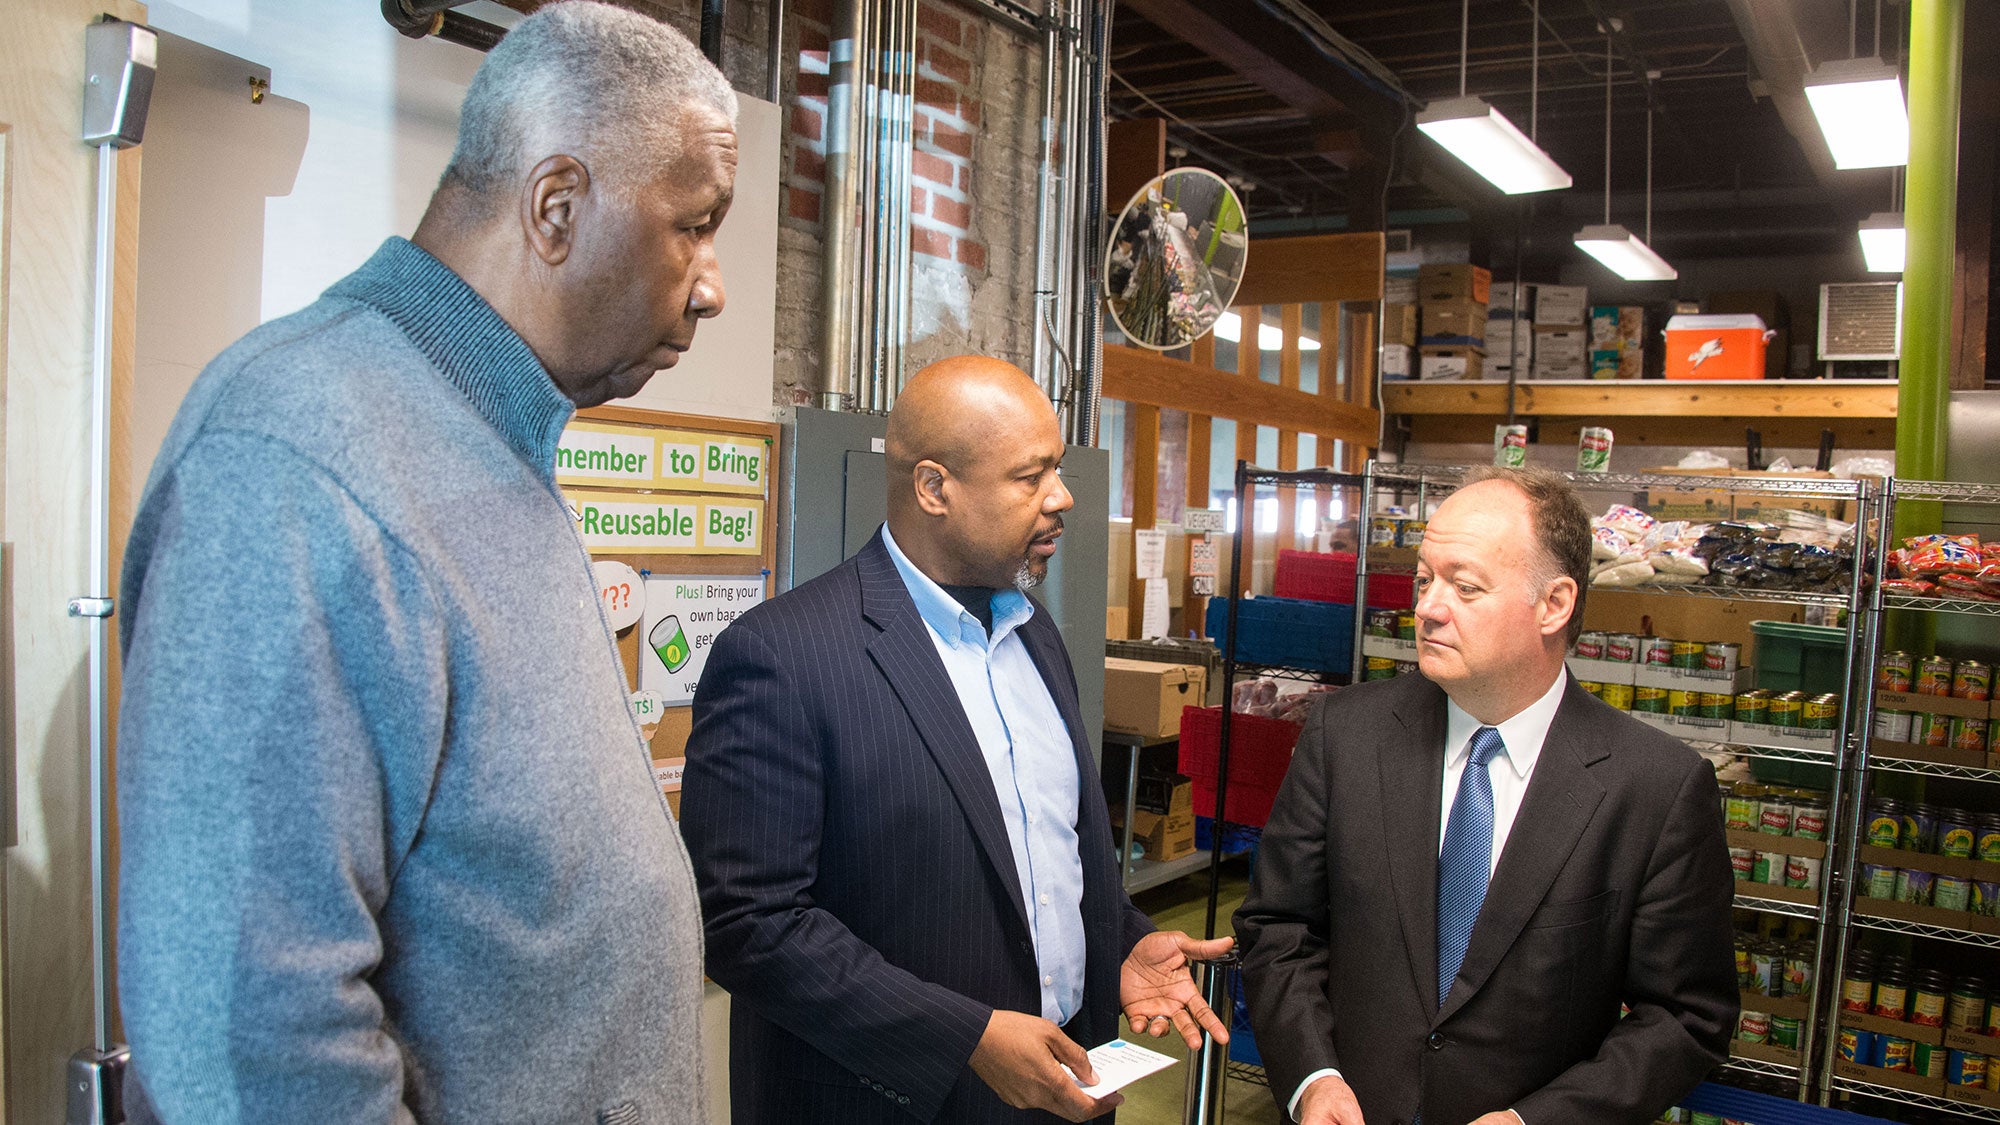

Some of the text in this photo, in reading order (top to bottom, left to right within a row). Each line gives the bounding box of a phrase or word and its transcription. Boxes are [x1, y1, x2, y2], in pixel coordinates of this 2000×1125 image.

[557, 444, 759, 482] member to Bring
[584, 507, 753, 542] Reusable Bag!
[676, 585, 758, 601] Plus! Bring your
[690, 612, 714, 622] own
[717, 608, 735, 623] bag
[695, 634, 713, 648] get
[1880, 694, 1906, 703] 12/300
[635, 699, 654, 714] TS!
[657, 771, 673, 780] able
[1948, 1034, 1976, 1046] 12/300
[1841, 1065, 1866, 1077] 12/300
[1953, 1090, 1981, 1101] 12/300
